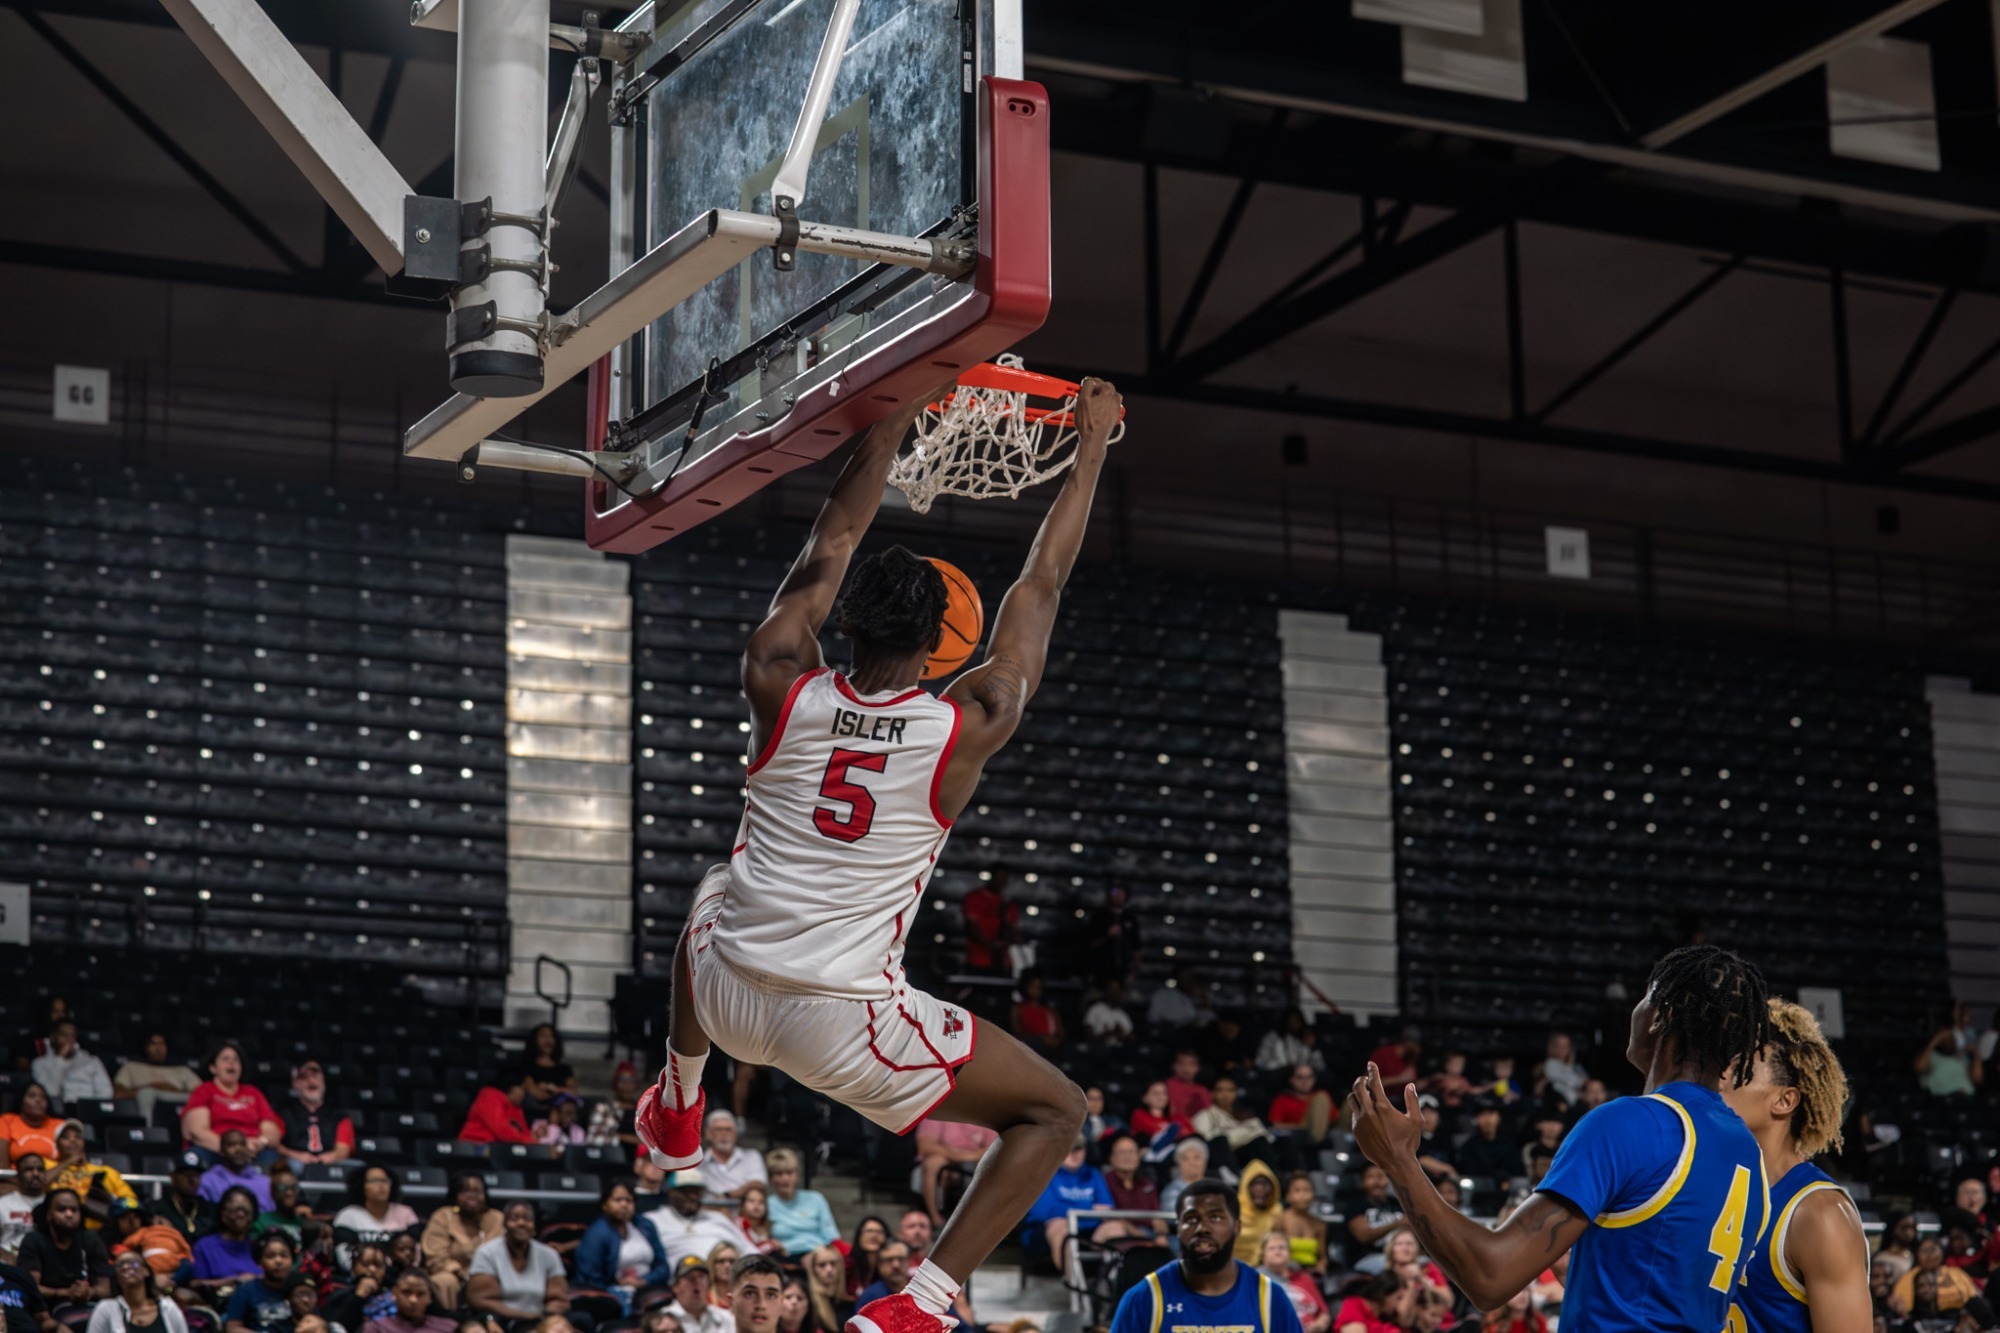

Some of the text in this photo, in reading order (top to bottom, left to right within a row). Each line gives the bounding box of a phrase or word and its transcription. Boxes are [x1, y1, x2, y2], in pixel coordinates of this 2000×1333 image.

[831, 707, 907, 744] ISLER
[813, 747, 889, 844] 5
[308, 1125, 323, 1152] 1
[1708, 1164, 1751, 1294] 4
